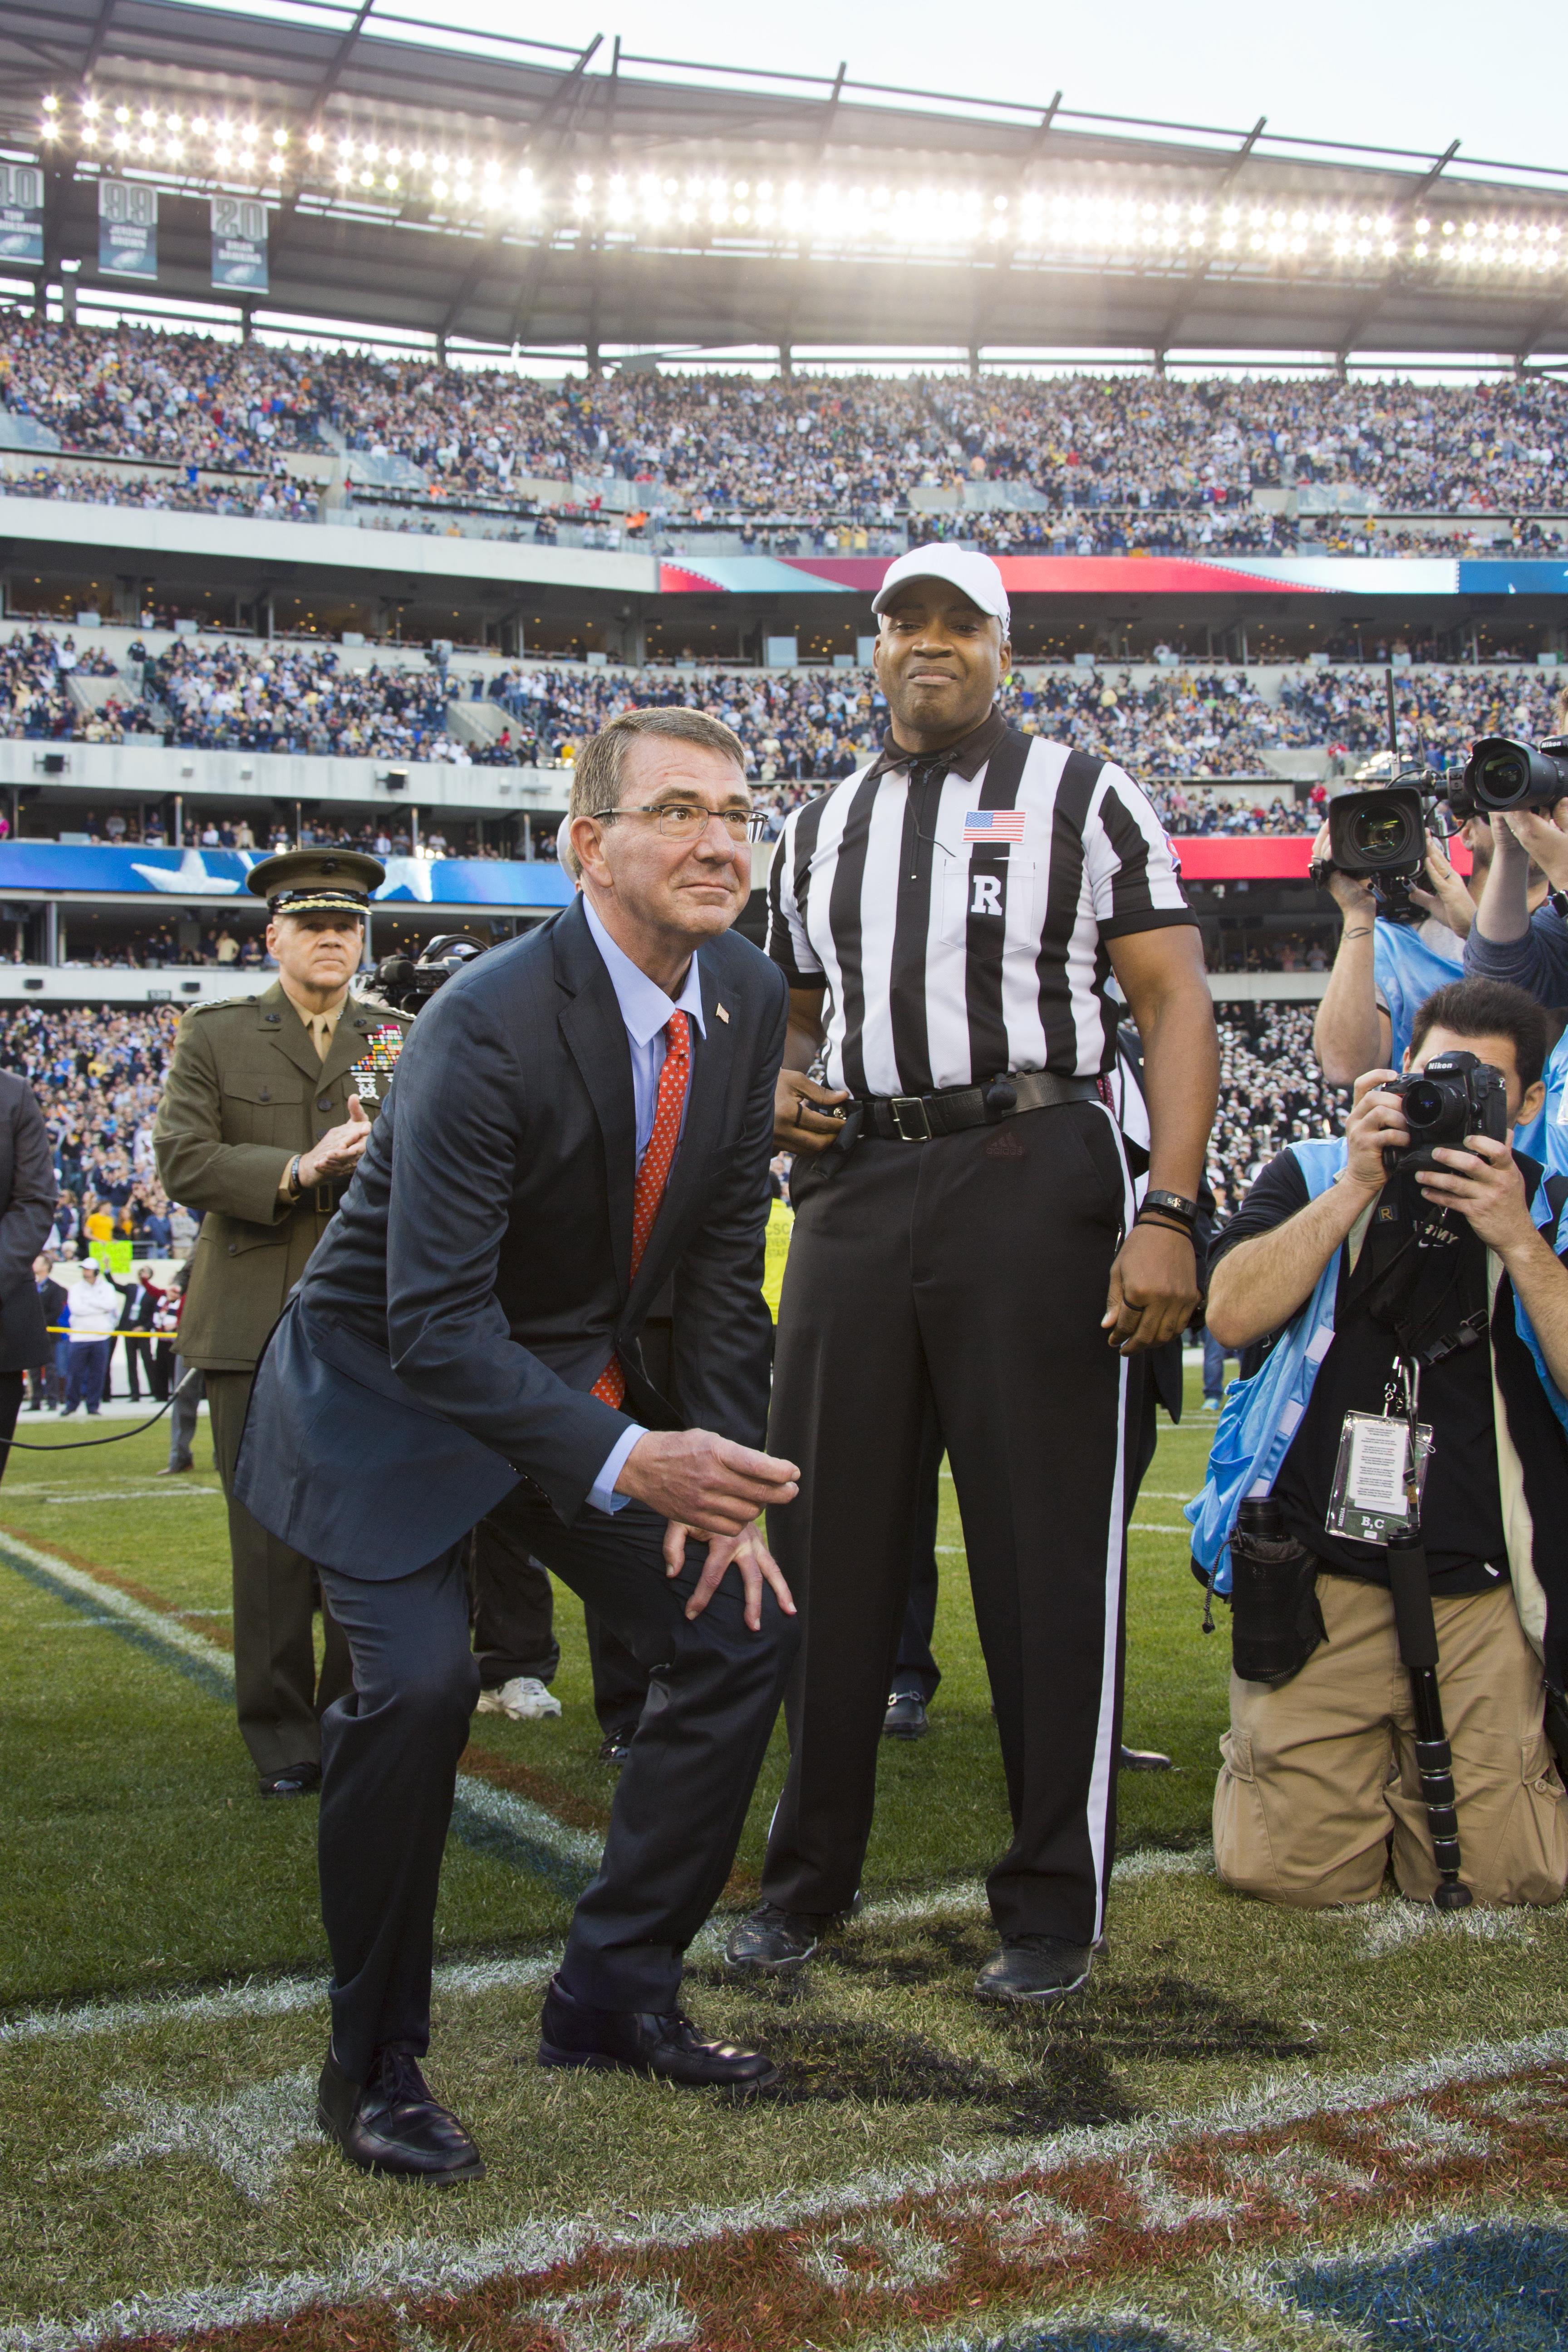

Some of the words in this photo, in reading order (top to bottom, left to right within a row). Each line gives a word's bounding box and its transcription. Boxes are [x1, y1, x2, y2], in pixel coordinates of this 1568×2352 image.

[105, 182, 153, 227] 99
[216, 197, 262, 242] 20
[1541, 741, 1562, 749] Nikon
[971, 875, 1003, 916] R
[1428, 1062, 1453, 1070] Nikon
[1337, 1507, 1346, 1527] MEDIA
[1361, 1516, 1385, 1529] B,C
